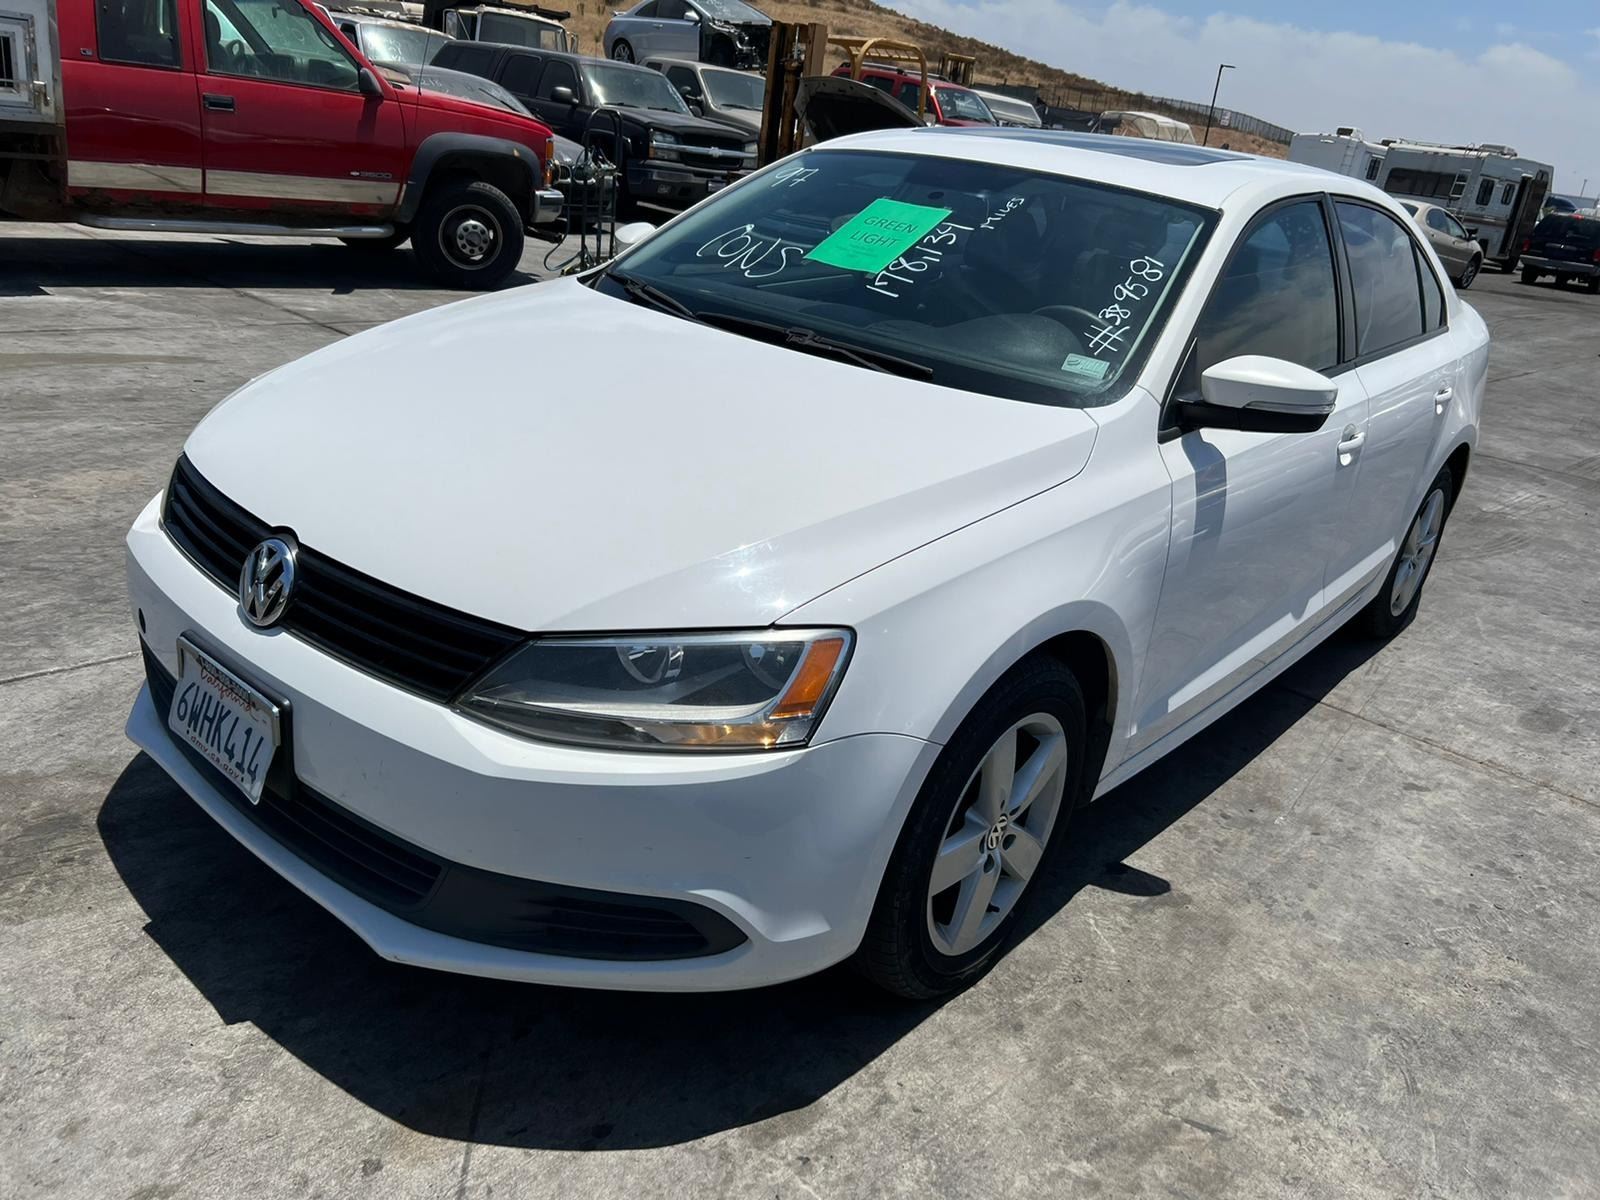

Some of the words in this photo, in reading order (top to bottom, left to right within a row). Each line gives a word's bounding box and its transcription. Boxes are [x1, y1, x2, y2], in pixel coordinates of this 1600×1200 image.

[863, 216, 918, 234] GREEN
[850, 230, 901, 248] LIGHT
[176, 681, 265, 785] 6WHK414
